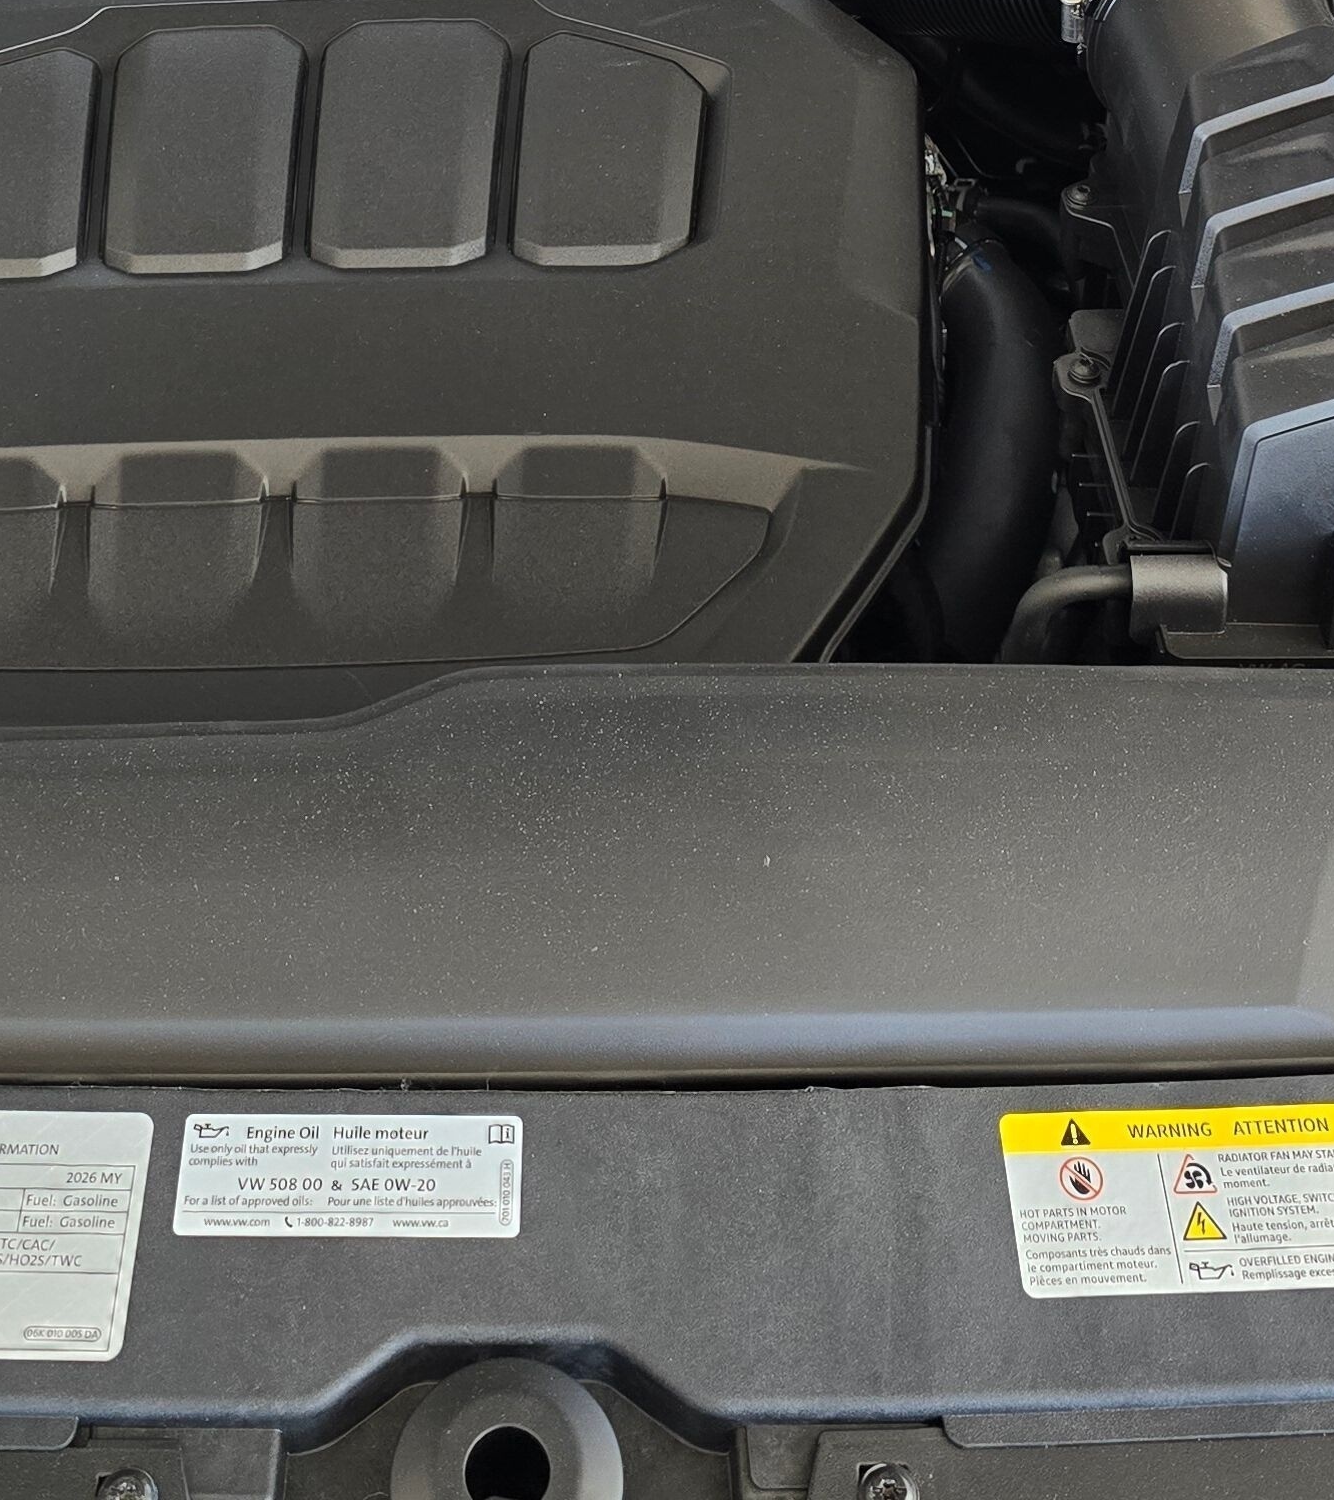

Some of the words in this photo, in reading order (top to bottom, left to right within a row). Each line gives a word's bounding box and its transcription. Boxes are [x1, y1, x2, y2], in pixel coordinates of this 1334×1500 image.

[246, 1125, 295, 1143] Engine
[299, 1125, 319, 1139] Oil
[333, 1125, 371, 1139] Huile
[375, 1126, 429, 1140] moteur
[1126, 1121, 1212, 1138] WARNING
[1233, 1117, 1329, 1136] ATTENTION
[190, 1143, 210, 1154] Use
[210, 1142, 233, 1157] only
[233, 1143, 247, 1154] oil
[248, 1143, 269, 1154] that
[271, 1143, 319, 1157] expressly
[331, 1144, 369, 1156] Utilisez
[370, 1145, 434, 1158] uniquement
[435, 1145, 449, 1156] de
[450, 1145, 482, 1157] l'huile
[1217, 1151, 1269, 1163] RADIATOR
[1269, 1150, 1290, 1161] FAN
[1291, 1149, 1313, 1160] MAY
[188, 1155, 233, 1169] complies
[235, 1155, 258, 1167] with
[330, 1156, 347, 1170] qui
[348, 1157, 390, 1169] satisfait
[391, 1157, 463, 1171] expressément
[464, 1158, 472, 1169] à
[65, 1171, 97, 1184] 2026
[99, 1171, 123, 1185] MY
[237, 1176, 265, 1191] VW
[269, 1177, 297, 1191] 508
[302, 1177, 323, 1191] 00
[330, 1179, 342, 1191] &
[351, 1177, 380, 1191] SAE
[384, 1178, 436, 1192] 0W-20
[1222, 1178, 1271, 1189] moment.
[25, 1193, 57, 1207] Fuel:
[63, 1193, 119, 1208] Gasoline
[183, 1194, 200, 1206] For
[201, 1197, 209, 1206] a
[210, 1194, 226, 1206] list
[228, 1194, 241, 1206] of
[241, 1194, 290, 1208] approved
[326, 1196, 351, 1207] Pour
[352, 1197, 372, 1207] une
[373, 1195, 395, 1207] liste
[395, 1195, 435, 1207] d'huiles
[1226, 1195, 1253, 1207] HIGH
[1019, 1208, 1040, 1219] HOT
[1042, 1207, 1074, 1218] PARTS
[1075, 1206, 1087, 1217] IN
[1089, 1205, 1127, 1216] MOTOR
[1228, 1206, 1275, 1218] IGNITION
[1276, 1204, 1319, 1216] SYSTEM.
[21, 1214, 53, 1231] Fuel:
[58, 1215, 115, 1231] Gasoline
[203, 1218, 270, 1227] www.vw.com
[296, 1216, 374, 1227] 1-800-822-8987
[392, 1219, 449, 1228] www.vw.ca
[1023, 1232, 1065, 1244] MOVING
[1066, 1230, 1102, 1242] PARTS.
[1233, 1232, 1292, 1245] l'allumage.
[1025, 1248, 1088, 1262] Composants
[1089, 1245, 1109, 1258] très
[1110, 1244, 1146, 1257] chauds
[1147, 1244, 1172, 1256] dans
[1027, 1262, 1037, 1273] le
[1039, 1259, 1114, 1274] compartiment
[1116, 1259, 1158, 1270] moteur.
[1238, 1254, 1301, 1267] OVERFILLED
[1029, 1274, 1063, 1286] Pièces
[1064, 1276, 1078, 1285] en
[1080, 1272, 1147, 1284] mouvement.
[1241, 1268, 1307, 1281] Remplissage
